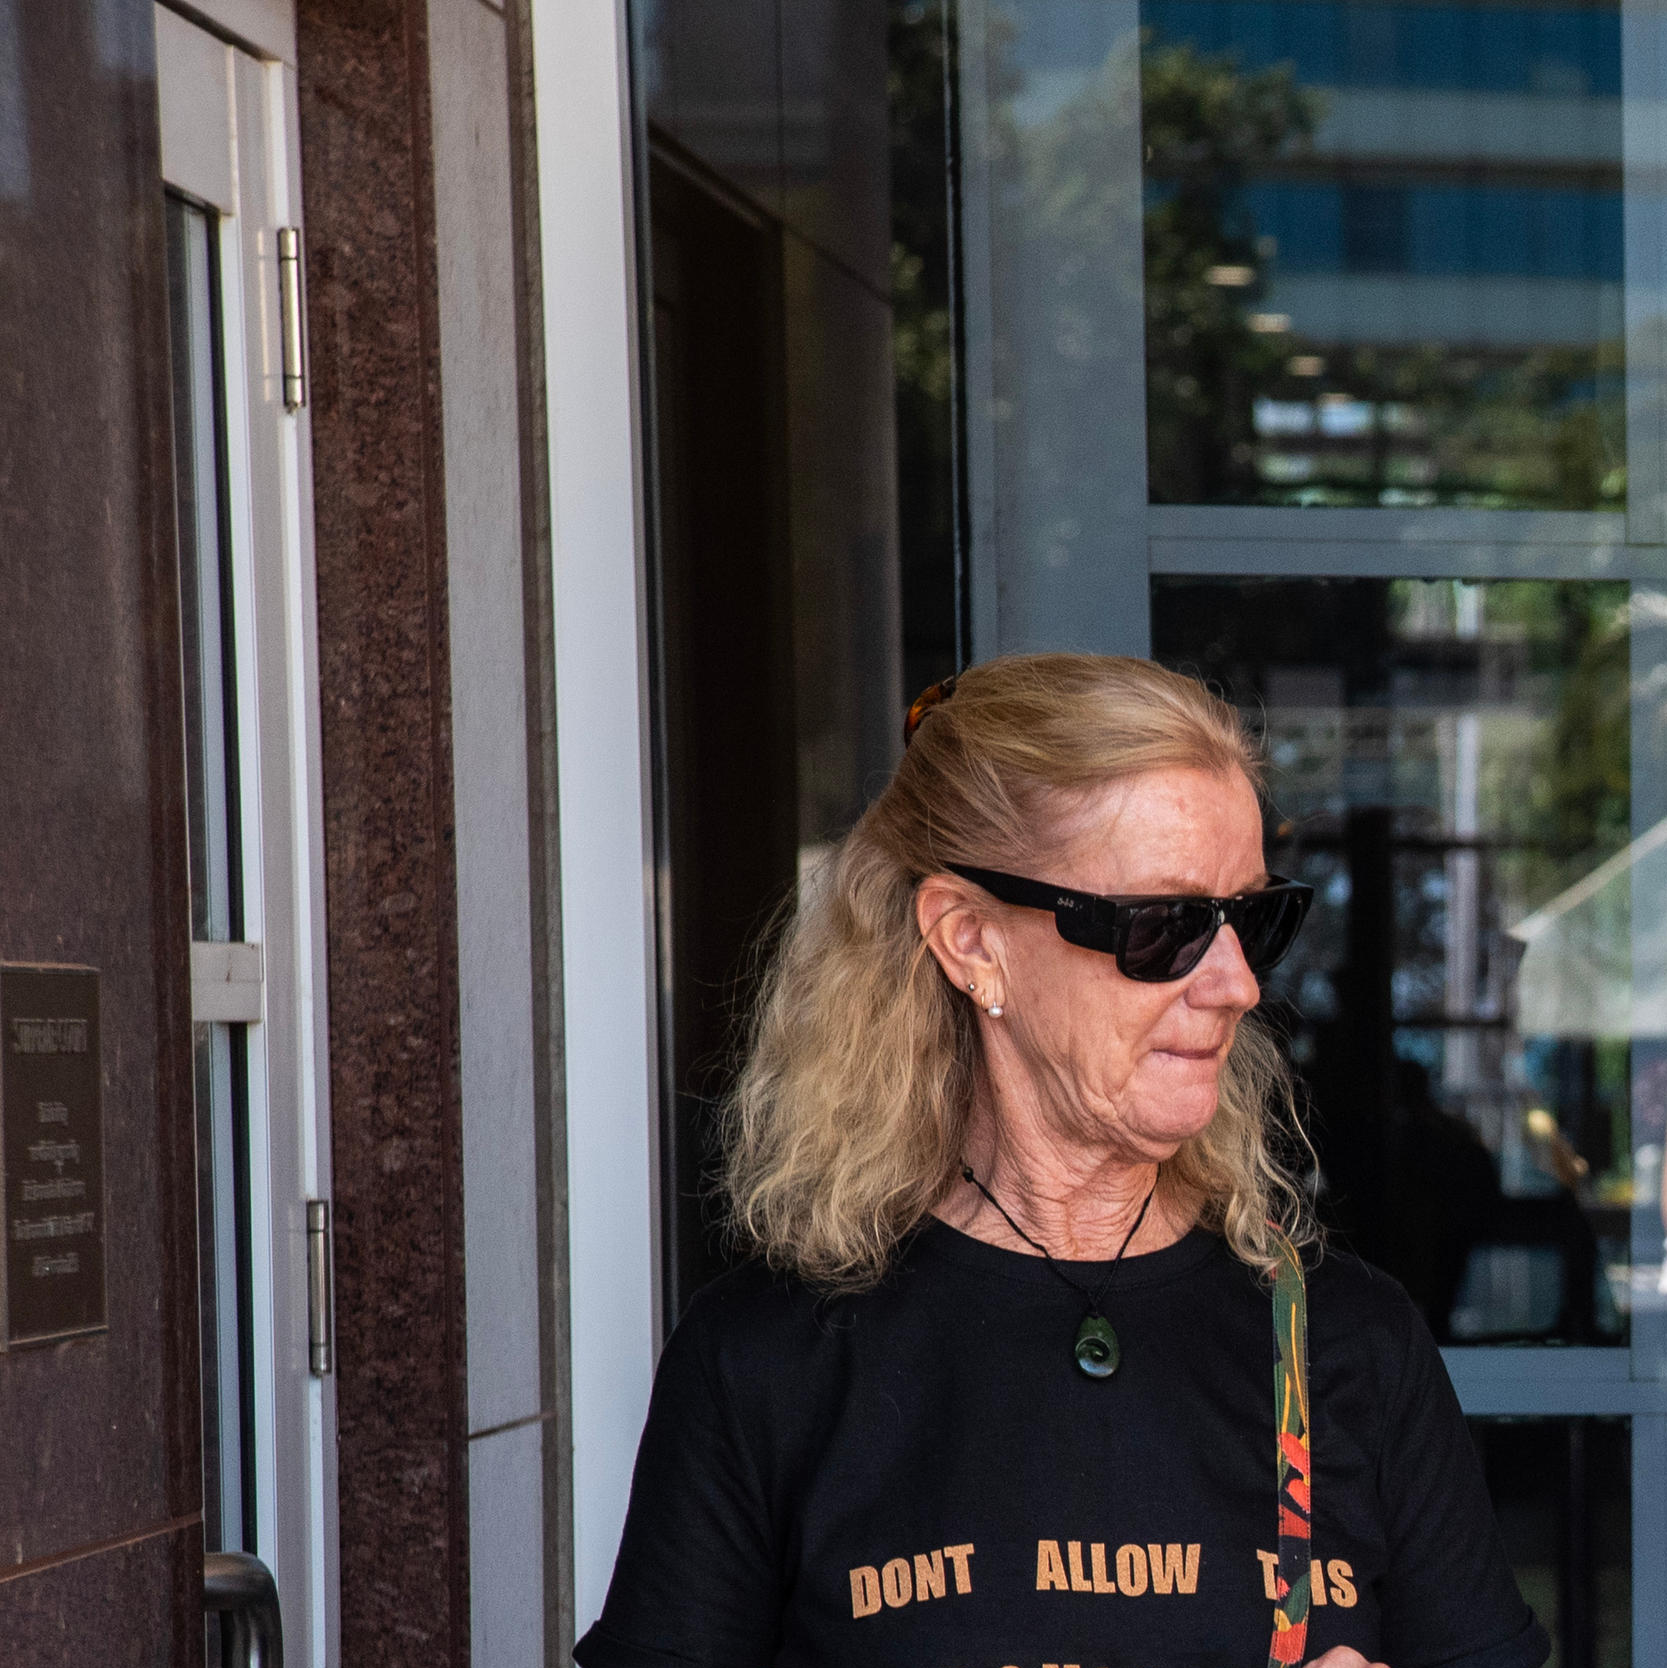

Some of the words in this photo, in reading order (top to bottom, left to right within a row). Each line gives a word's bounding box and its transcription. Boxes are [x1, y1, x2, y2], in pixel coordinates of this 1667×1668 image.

[849, 1543, 975, 1619] DONT
[1036, 1539, 1201, 1597] ALLOW
[1256, 1548, 1358, 1608] TIS
